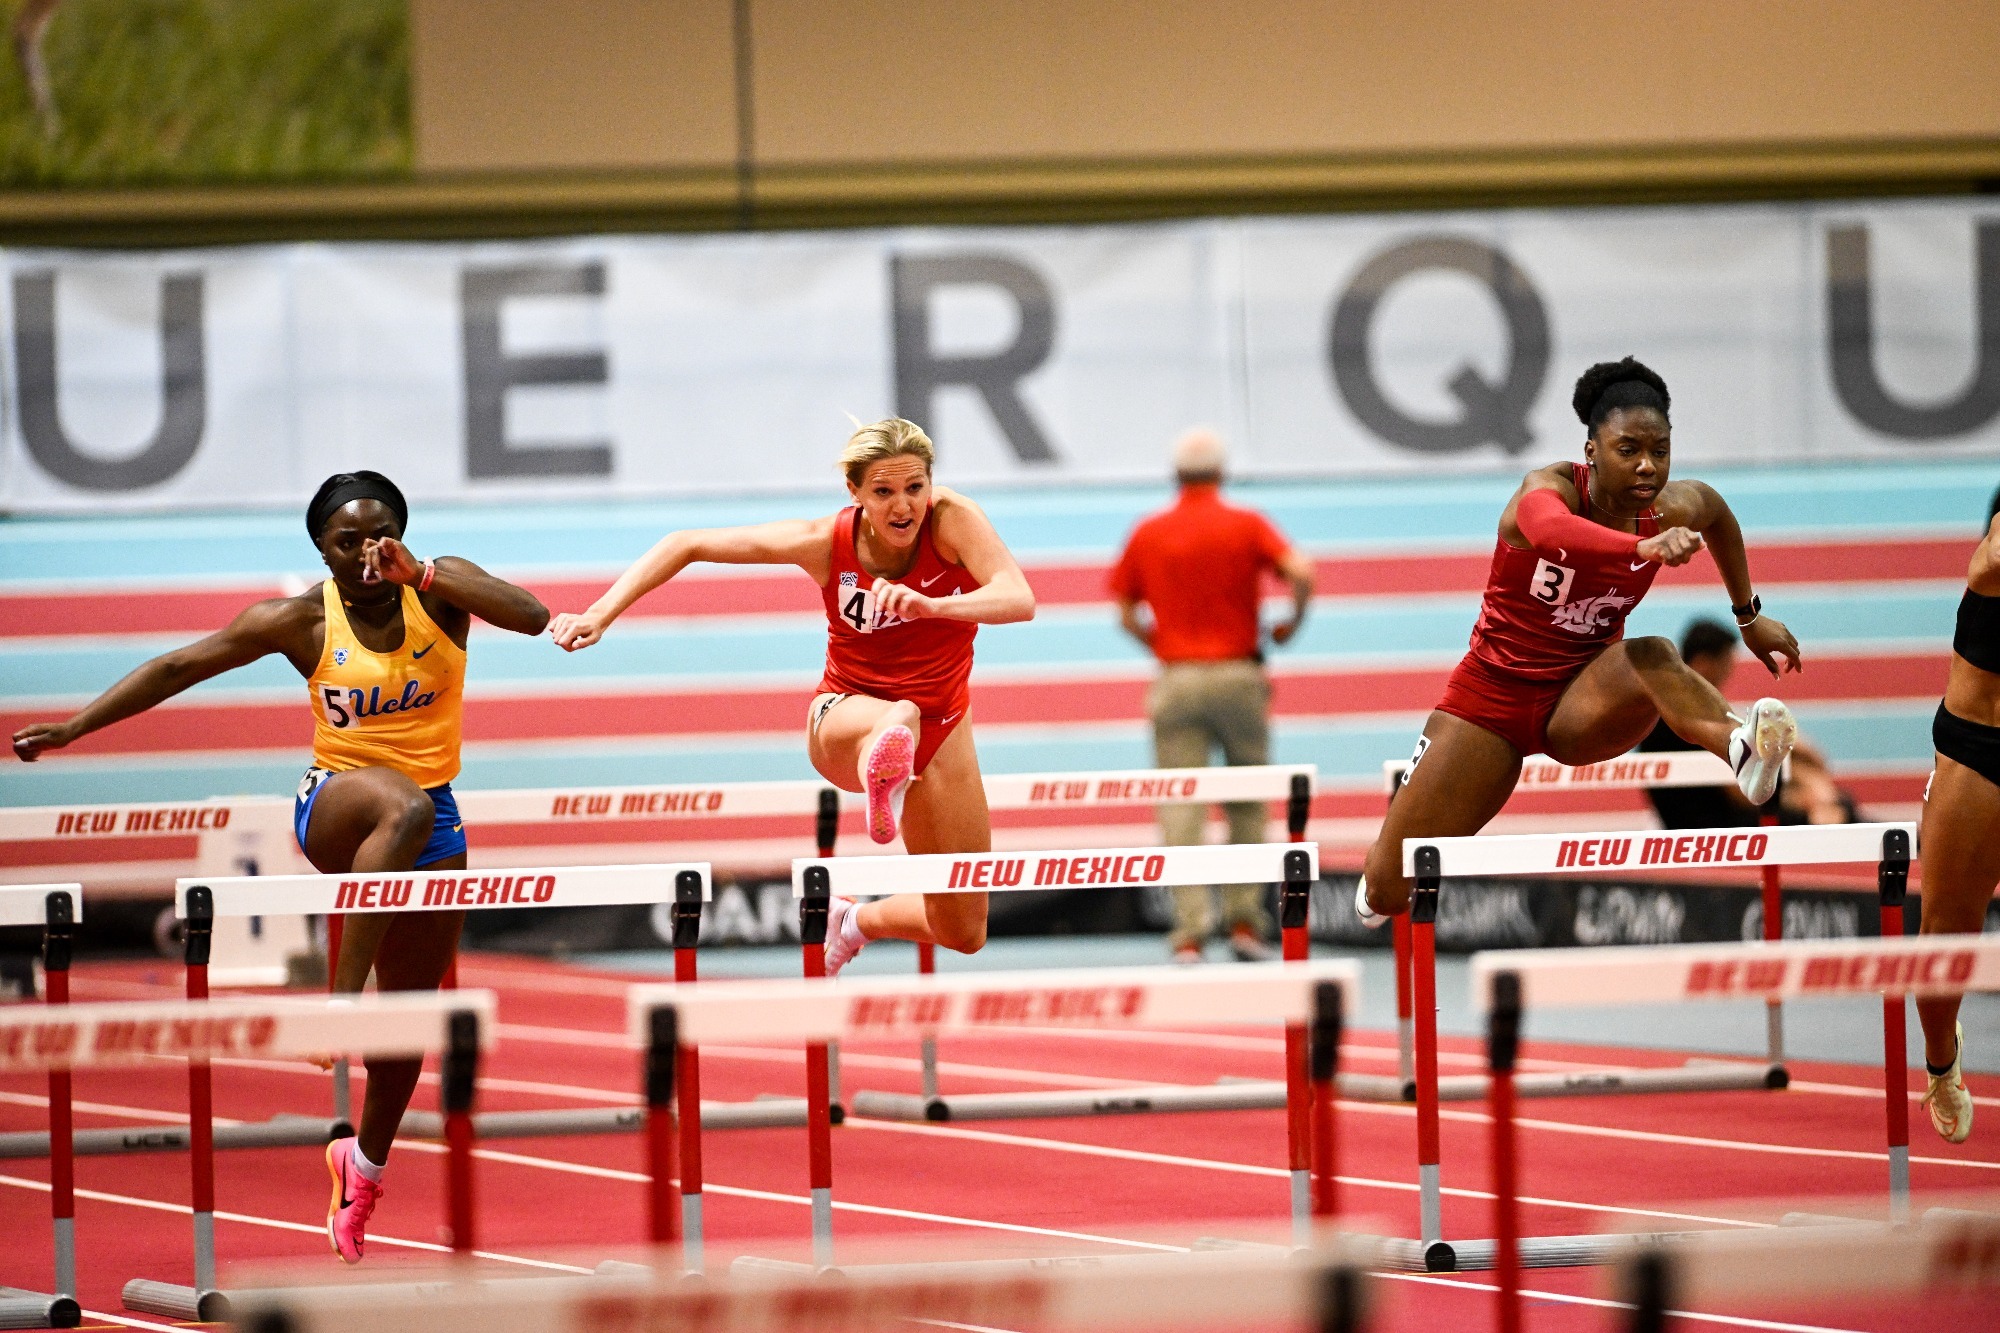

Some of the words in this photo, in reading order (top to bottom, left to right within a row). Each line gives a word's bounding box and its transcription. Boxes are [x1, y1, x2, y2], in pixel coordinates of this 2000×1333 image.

[1537, 565, 1565, 603] 3
[844, 591, 867, 631] 4
[324, 688, 350, 728] 5
[1029, 781, 1089, 801] NEW
[1097, 776, 1198, 800] MEXICO
[1522, 765, 1562, 783] EW
[1571, 761, 1671, 783] MEXICO
[55, 811, 118, 835] NEW
[124, 807, 231, 833] MEXICO
[551, 794, 612, 816] NEW
[619, 791, 724, 815] MEXICO
[1556, 838, 1632, 868] NEW
[1639, 834, 1769, 866] MEXICO
[947, 859, 1026, 889] NEW
[1033, 854, 1166, 886] MEXICO
[335, 880, 414, 909] NEW
[422, 874, 556, 906] MEXICO
[1687, 958, 1787, 993] NEW
[1801, 951, 1976, 989] MEXICO
